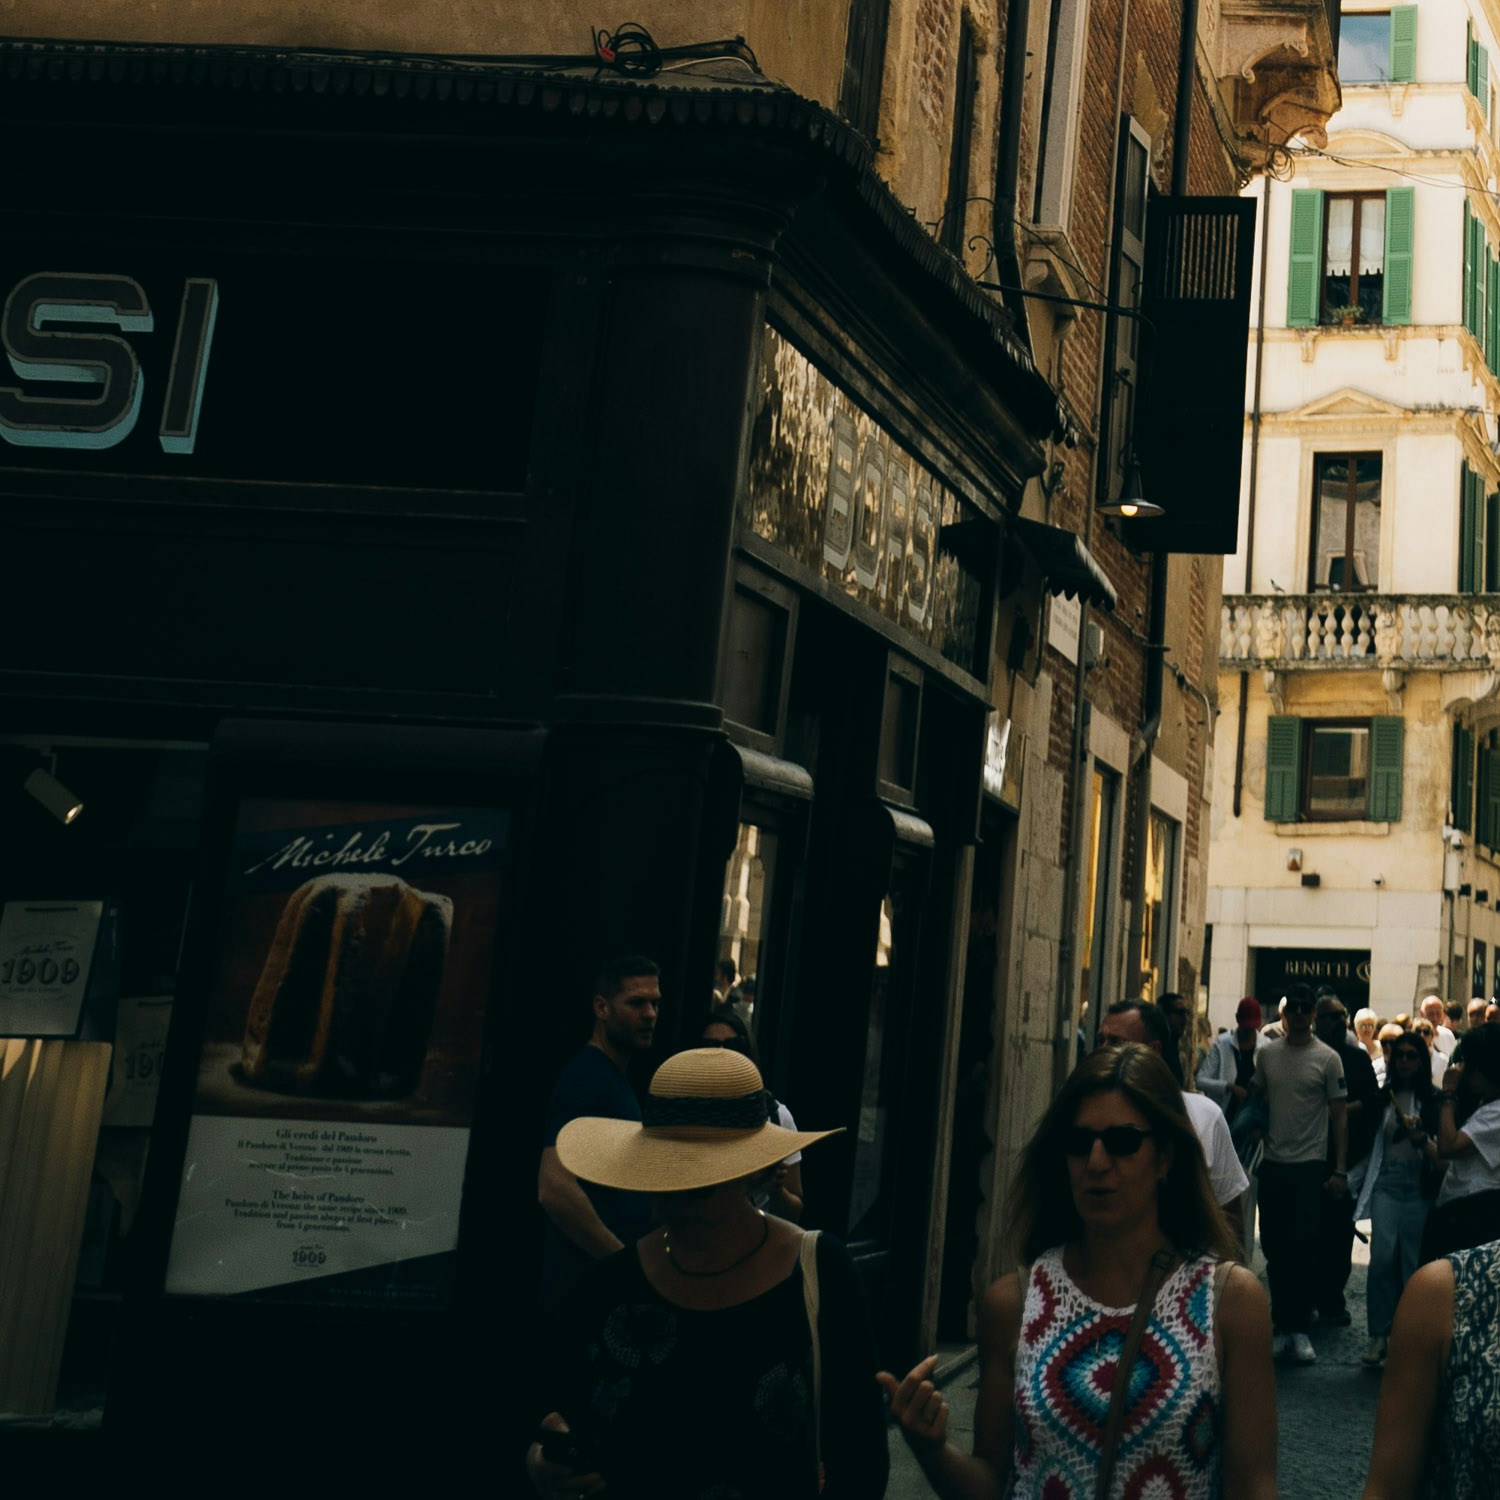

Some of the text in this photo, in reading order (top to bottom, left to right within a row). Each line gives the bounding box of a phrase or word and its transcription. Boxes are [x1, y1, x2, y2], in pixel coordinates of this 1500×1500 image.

[0, 271, 219, 454] SI
[243, 822, 492, 876] Michele Turco
[1, 957, 80, 985] 1909
[1284, 959, 1350, 979] BENETTI
